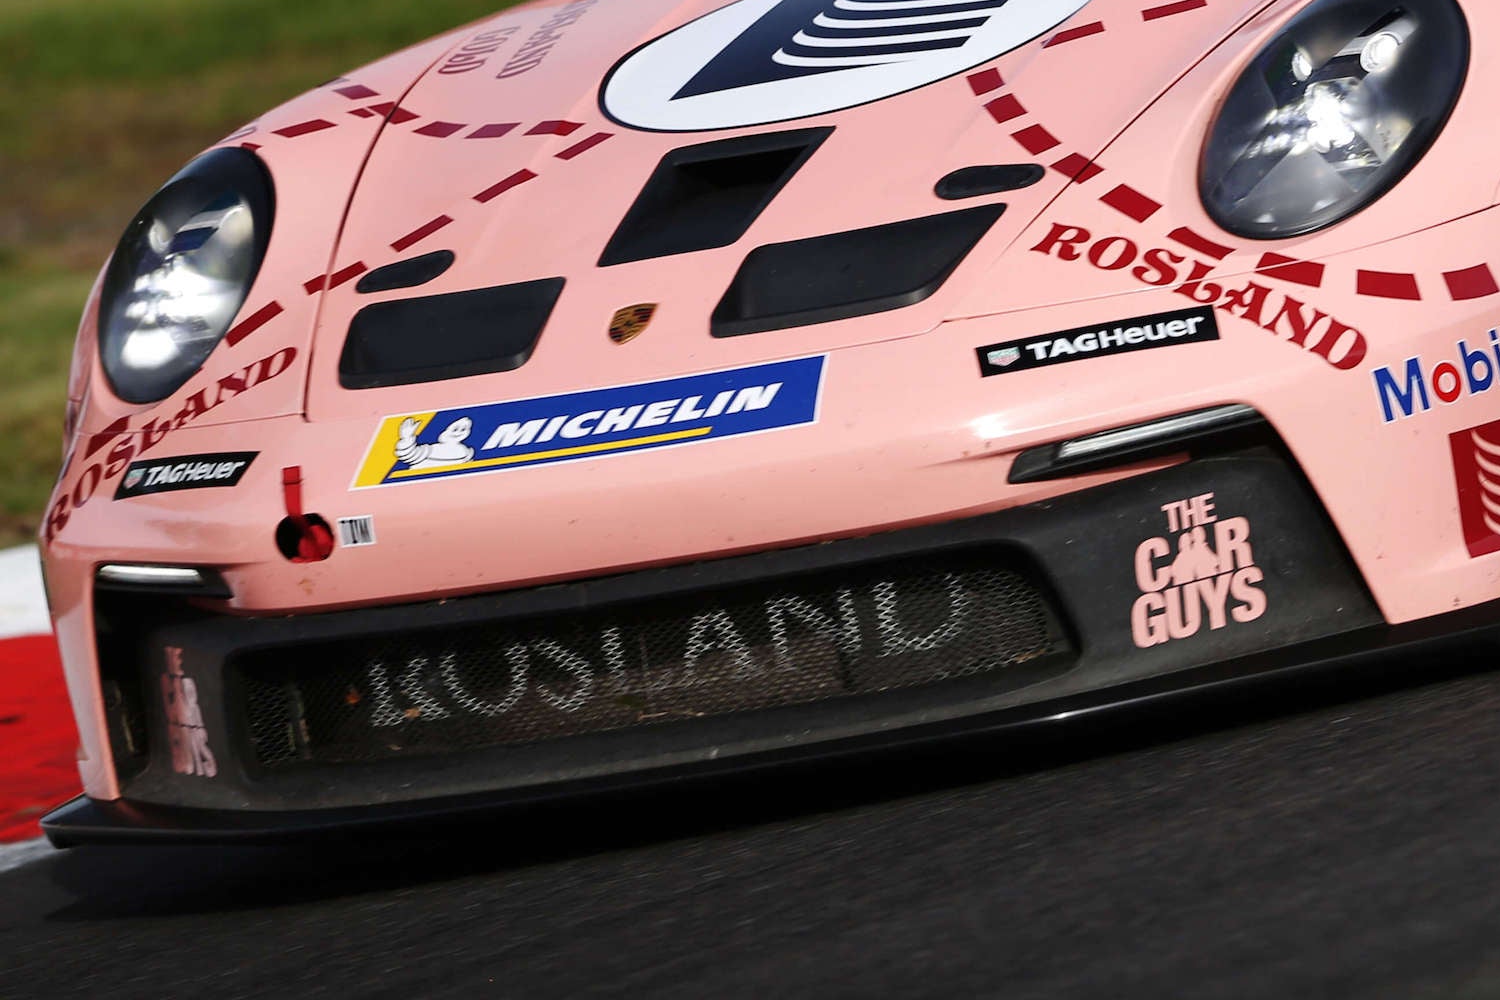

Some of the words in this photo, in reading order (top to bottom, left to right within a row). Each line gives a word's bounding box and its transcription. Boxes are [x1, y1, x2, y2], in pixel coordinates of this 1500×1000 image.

[1030, 222, 1368, 371] ROSLAND
[45, 347, 297, 545] ROSLAND
[480, 382, 784, 452] MICHELIN
[1161, 492, 1216, 534] THE
[1133, 515, 1254, 594] CAR
[1130, 567, 1267, 649] GUYS
